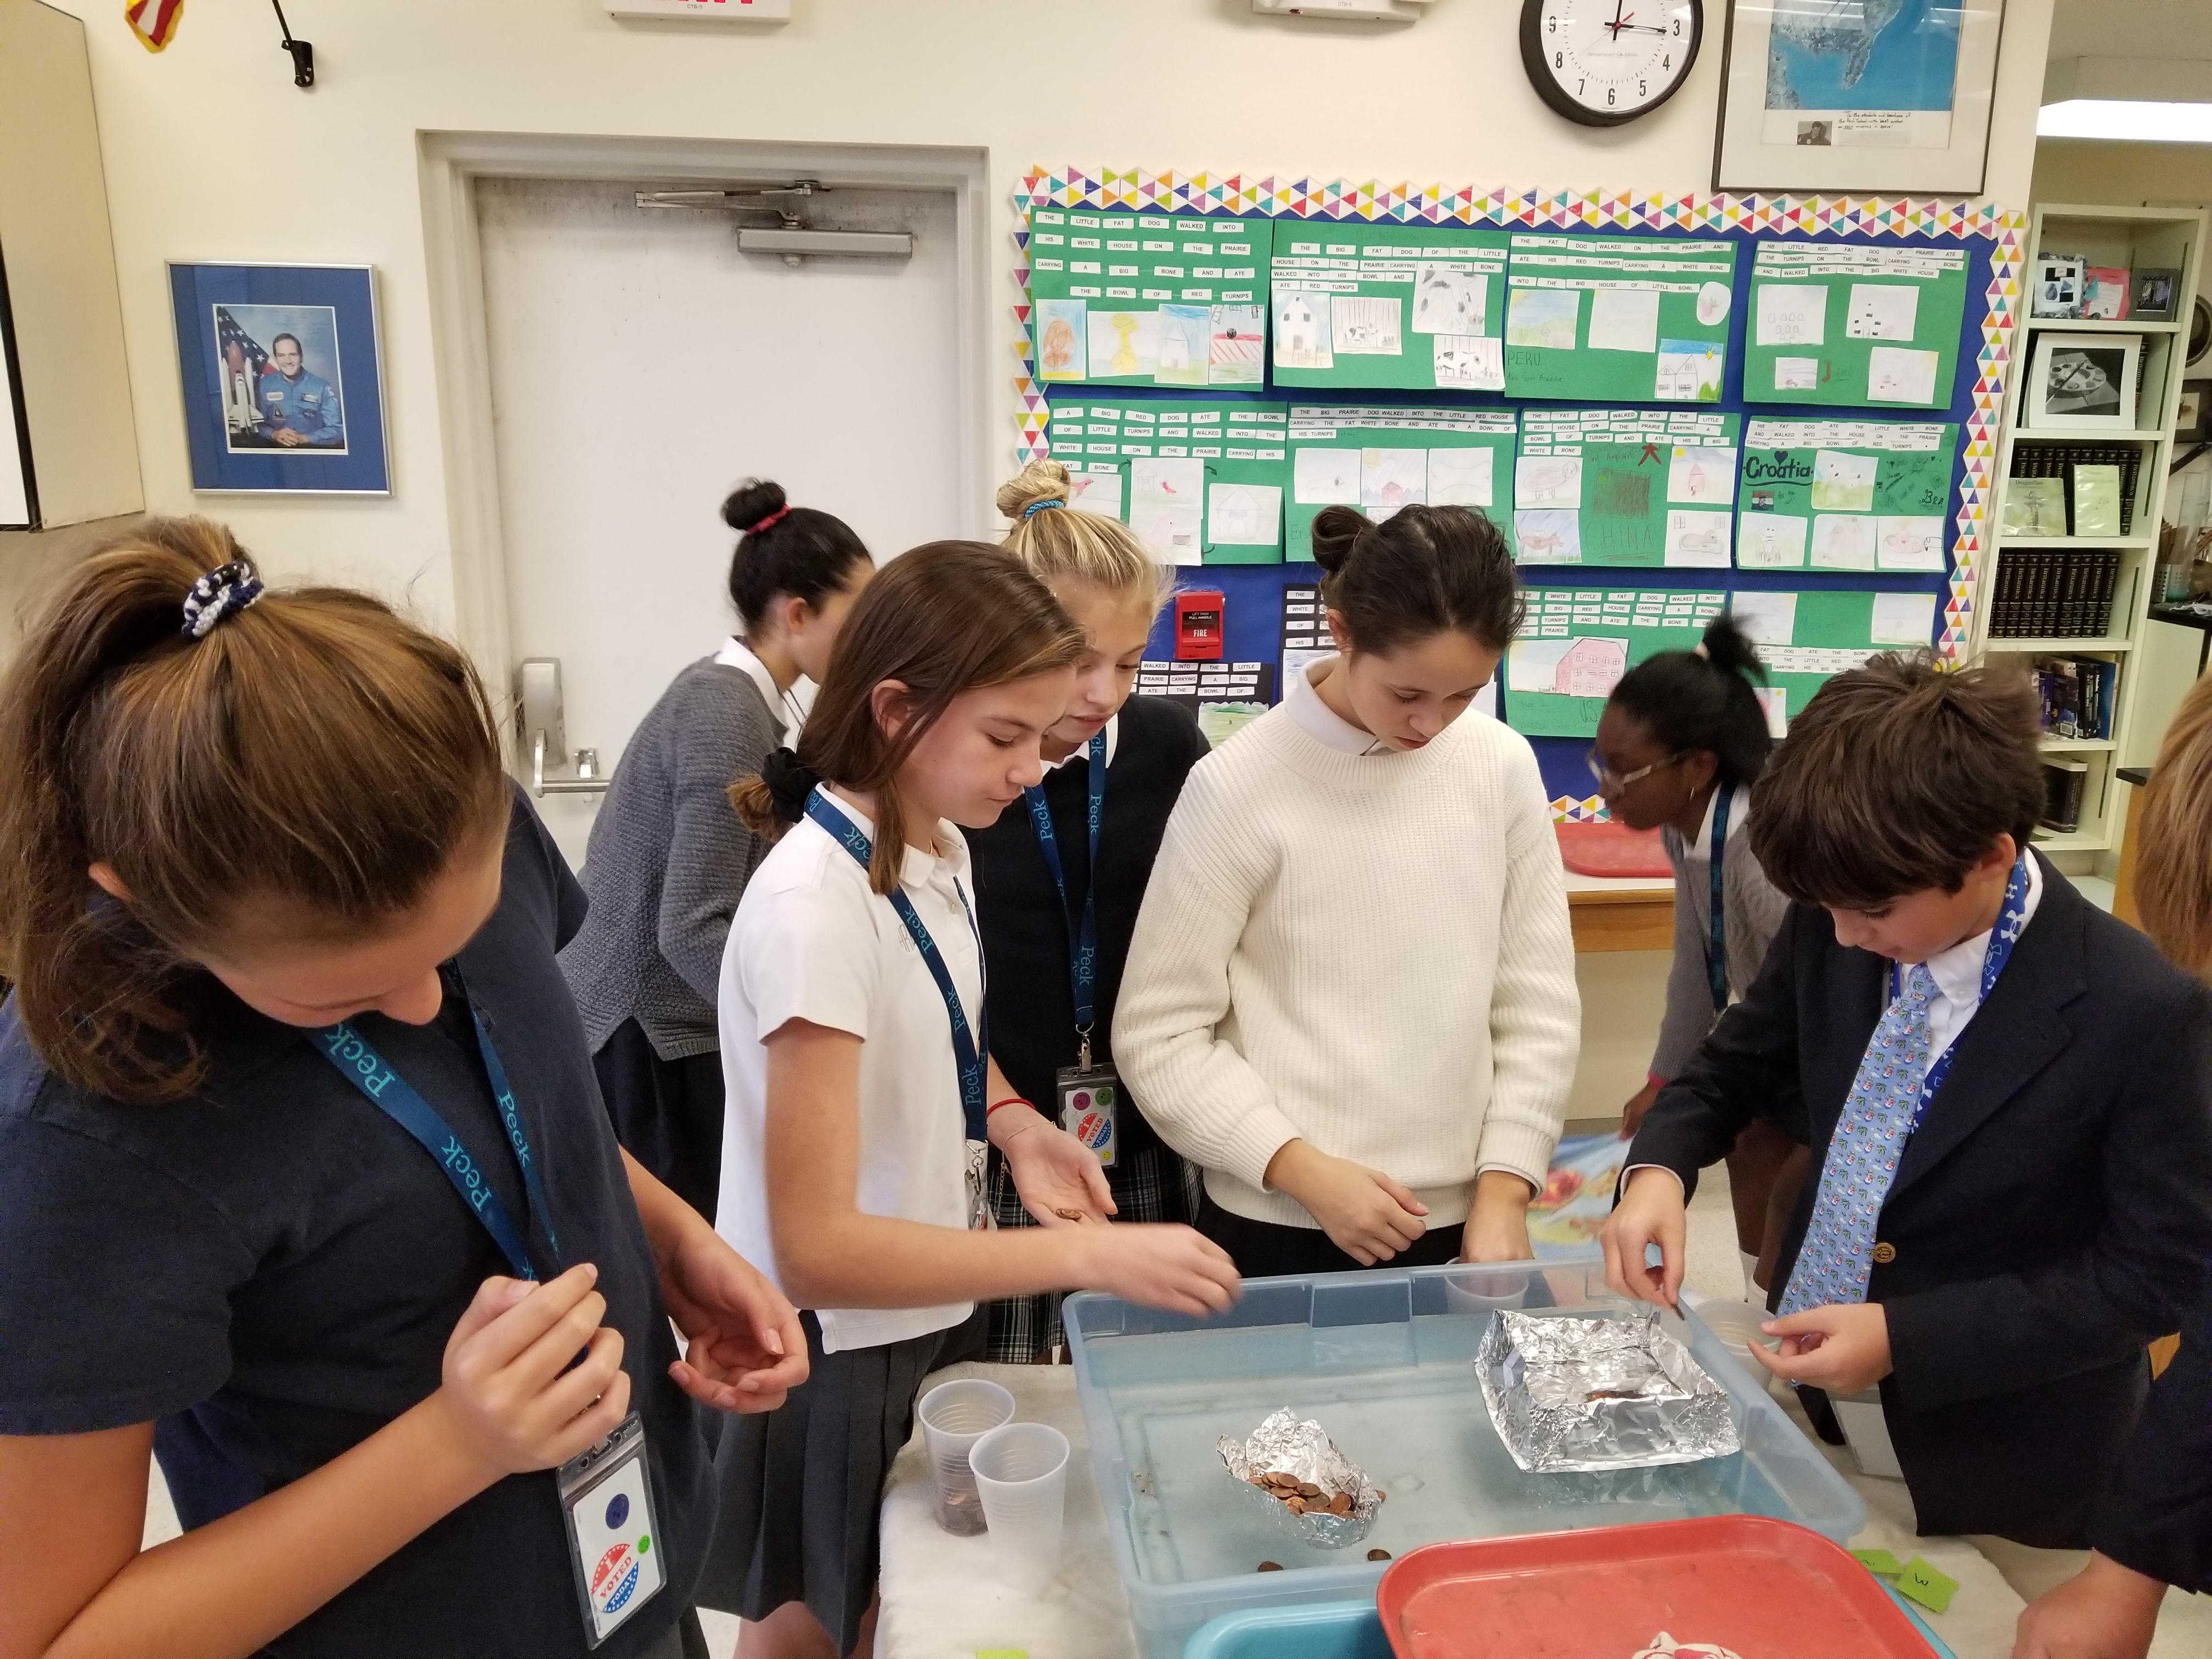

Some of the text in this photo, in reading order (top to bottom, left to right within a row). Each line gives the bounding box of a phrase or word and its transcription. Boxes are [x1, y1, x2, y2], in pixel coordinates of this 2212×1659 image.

[1549, 16, 1556, 33] 9
[1673, 19, 1680, 36] 3
[1555, 52, 1562, 68] 8
[1663, 54, 1670, 71] 4
[1579, 78, 1585, 95] 7
[1608, 88, 1615, 105] 6
[1639, 80, 1646, 97] 5
[1508, 351, 1541, 366] PERU
[1746, 456, 1810, 479] Croatia
[1193, 629, 1207, 637] FIRE
[1033, 799, 1053, 841] Peck
[1090, 794, 1102, 834] Peck
[844, 826, 872, 859] eck
[905, 905, 933, 954] Peck
[1079, 945, 1094, 986] Peck
[947, 985, 966, 1034] Peck
[325, 1023, 396, 1097] Peck
[962, 1064, 981, 1105] Peck
[498, 1090, 530, 1167] Peck
[1086, 1118, 1103, 1142] VOTED
[1097, 1125, 1108, 1143] TODAY
[441, 1136, 493, 1212] Peck
[599, 1556, 631, 1599] VOTED
[605, 1559, 614, 1572] I
[610, 1575, 634, 1605] TODAY
